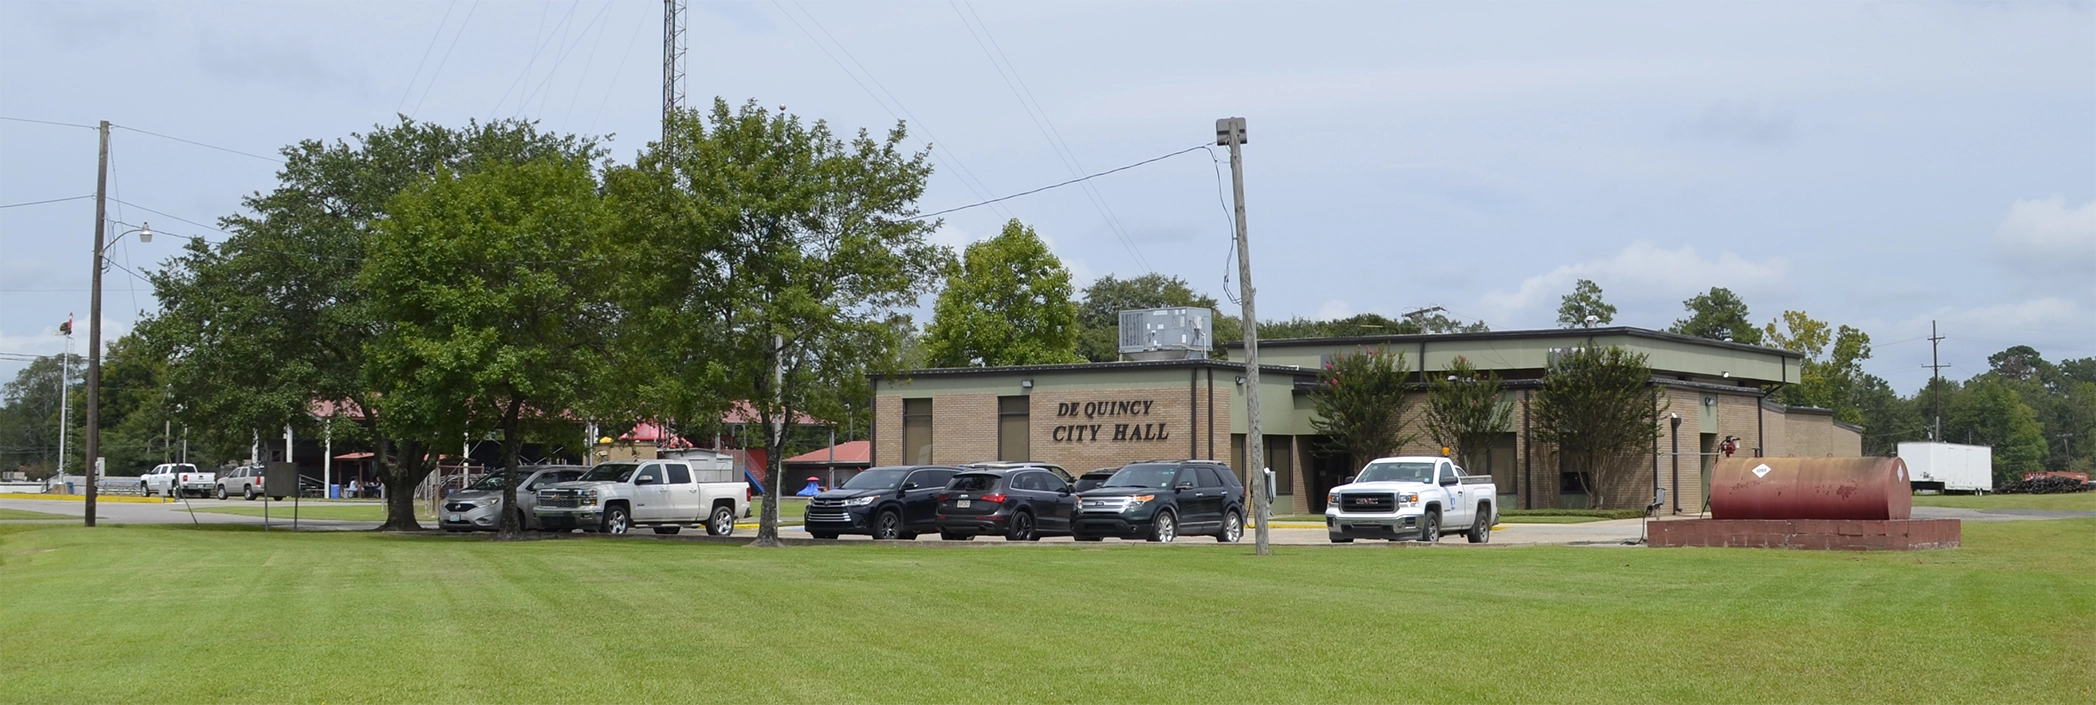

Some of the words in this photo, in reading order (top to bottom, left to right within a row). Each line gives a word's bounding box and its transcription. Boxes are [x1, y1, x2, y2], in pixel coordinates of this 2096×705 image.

[1057, 402, 1080, 417] DE
[1084, 400, 1154, 419] QUINCY
[1052, 424, 1102, 442] CITY
[1112, 423, 1170, 441] HALL
[1355, 497, 1379, 505] GMC
